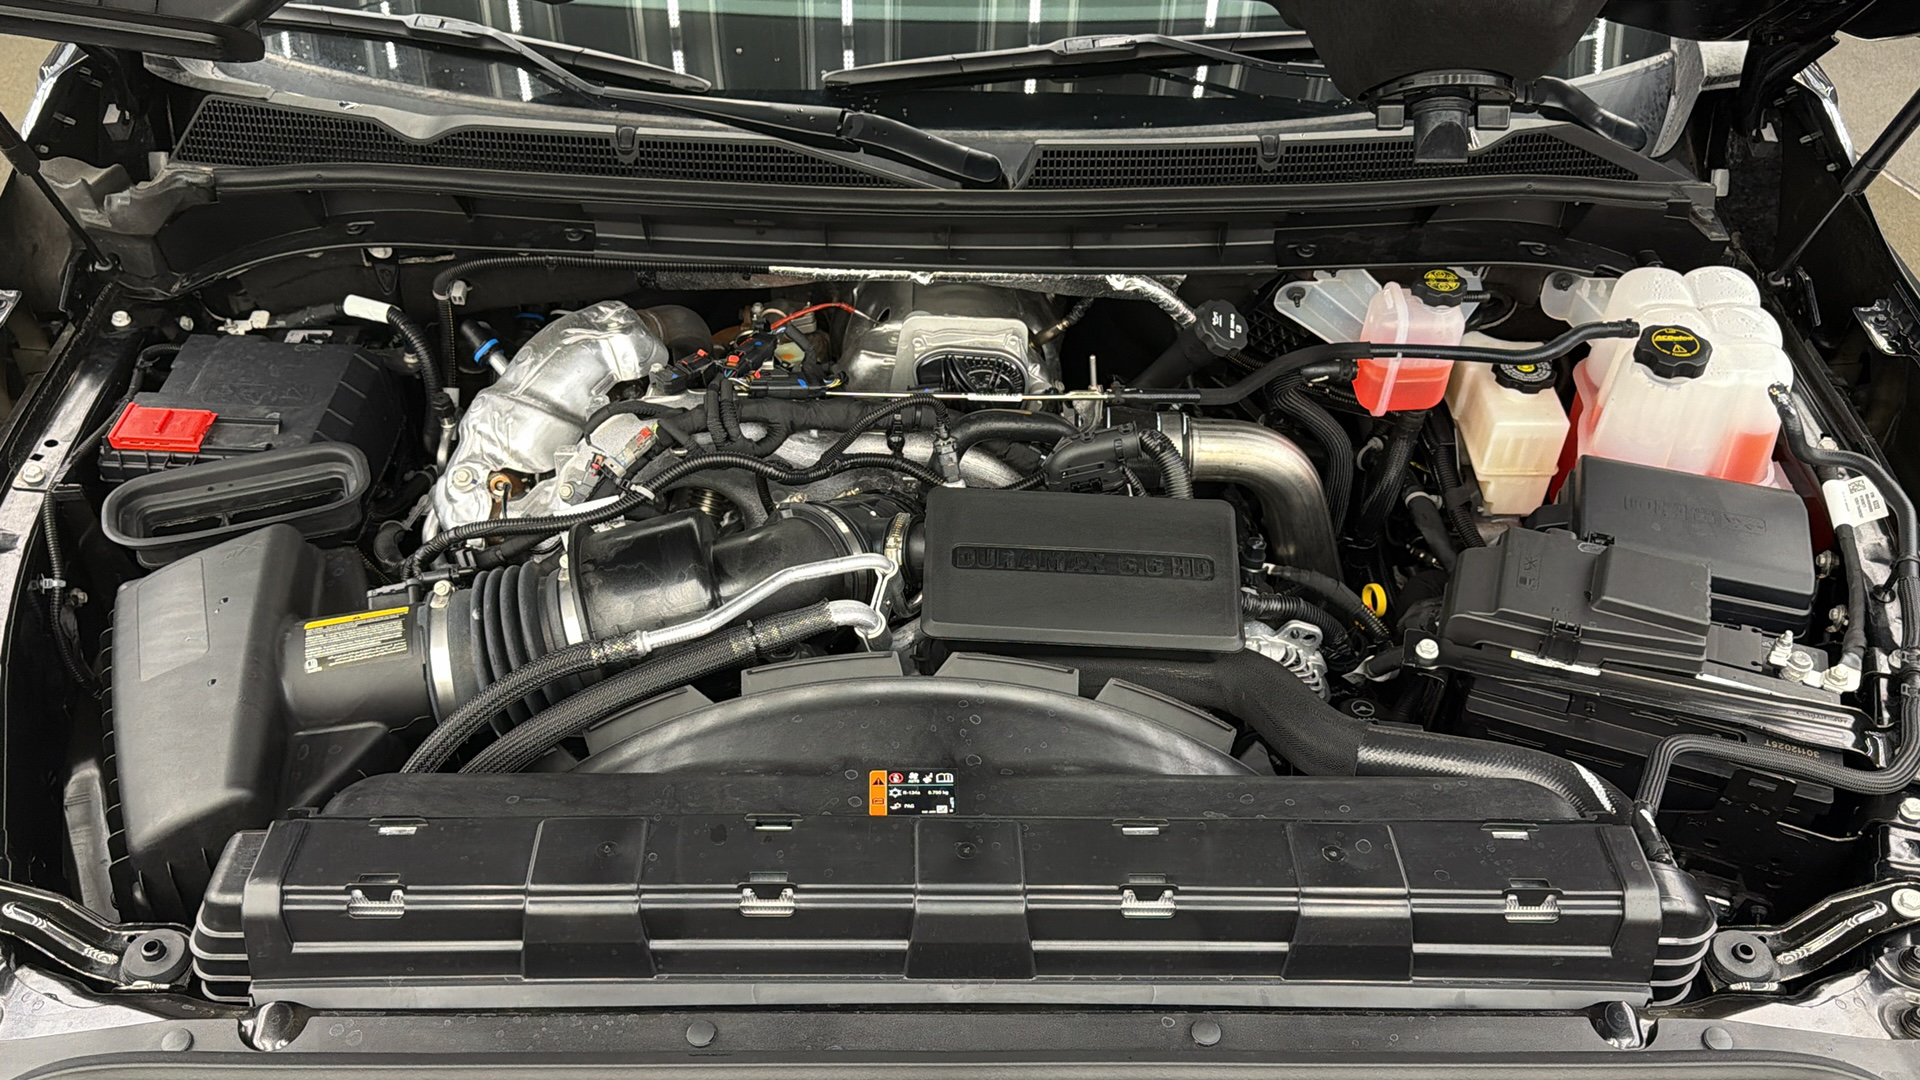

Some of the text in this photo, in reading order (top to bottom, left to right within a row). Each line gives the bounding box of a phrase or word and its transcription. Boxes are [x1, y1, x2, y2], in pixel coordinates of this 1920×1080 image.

[956, 549, 1212, 581] DURAMAX 6.6 HD
